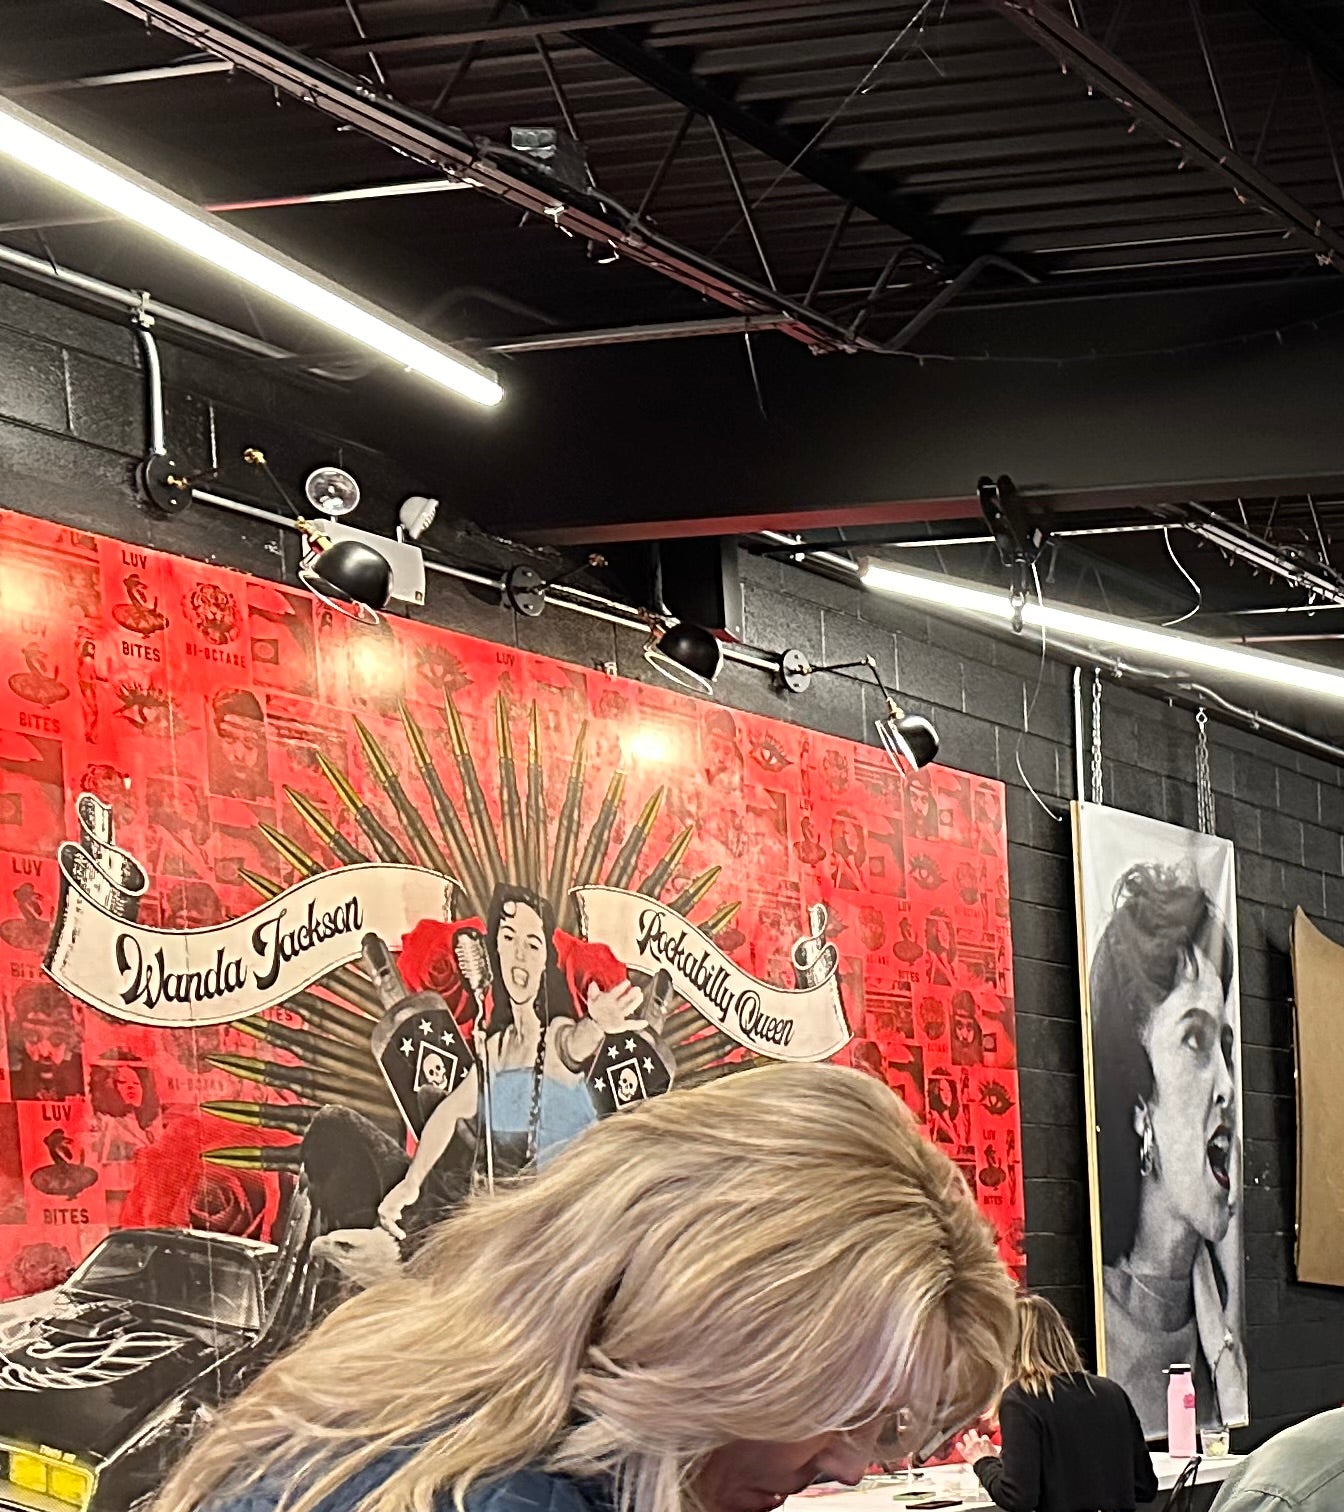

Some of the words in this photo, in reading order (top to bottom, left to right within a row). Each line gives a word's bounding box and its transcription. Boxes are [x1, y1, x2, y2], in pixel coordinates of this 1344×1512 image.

[121, 550, 147, 569] LUV
[121, 641, 161, 663] BITES
[19, 711, 61, 734] BITES
[12, 856, 43, 876] LUV
[115, 933, 248, 1010] Wanda
[252, 896, 364, 990] Jackson
[636, 908, 735, 1023] Rockabilly
[735, 989, 794, 1047] Queen
[42, 1103, 72, 1122] LUV
[43, 1208, 89, 1225] BITES
